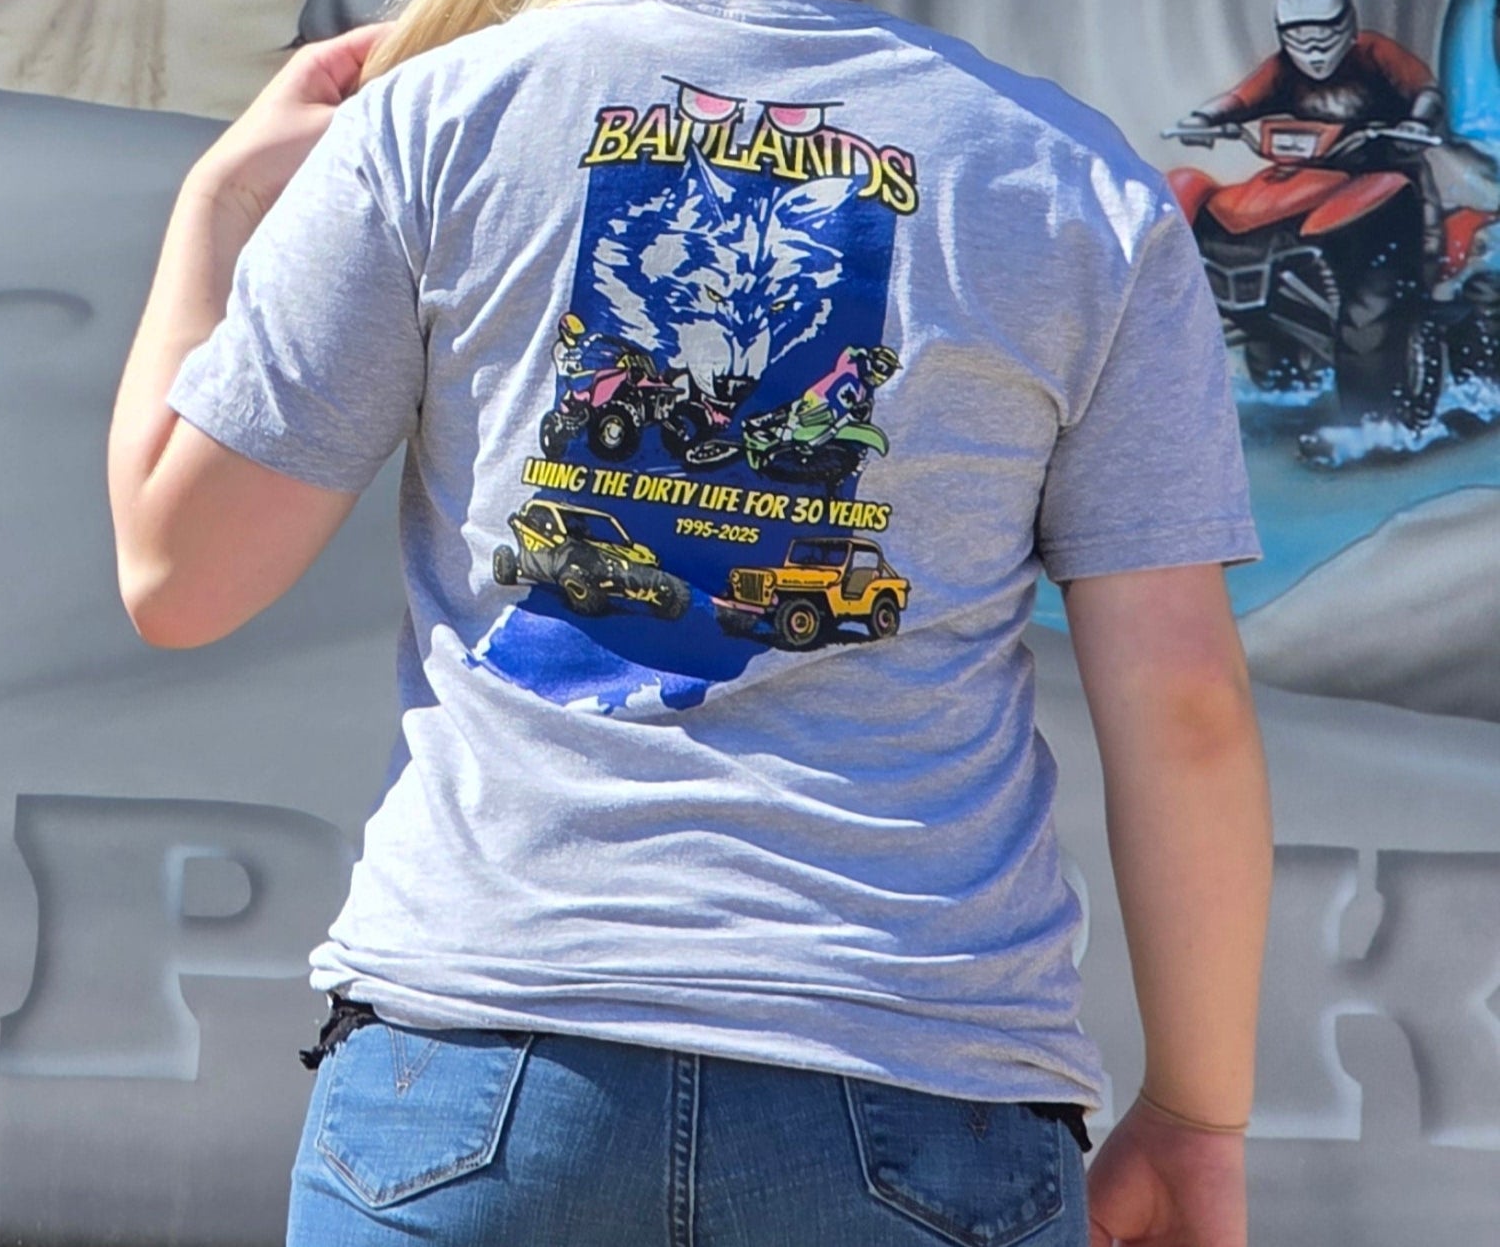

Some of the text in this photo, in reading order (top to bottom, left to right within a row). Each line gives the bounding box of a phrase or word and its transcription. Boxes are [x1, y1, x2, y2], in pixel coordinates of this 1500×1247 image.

[579, 102, 919, 216] BADLANDS
[521, 457, 892, 532] LIVING THE DIRTY LIFE FOR 30 YEARS
[675, 517, 761, 545] 1995-2025
